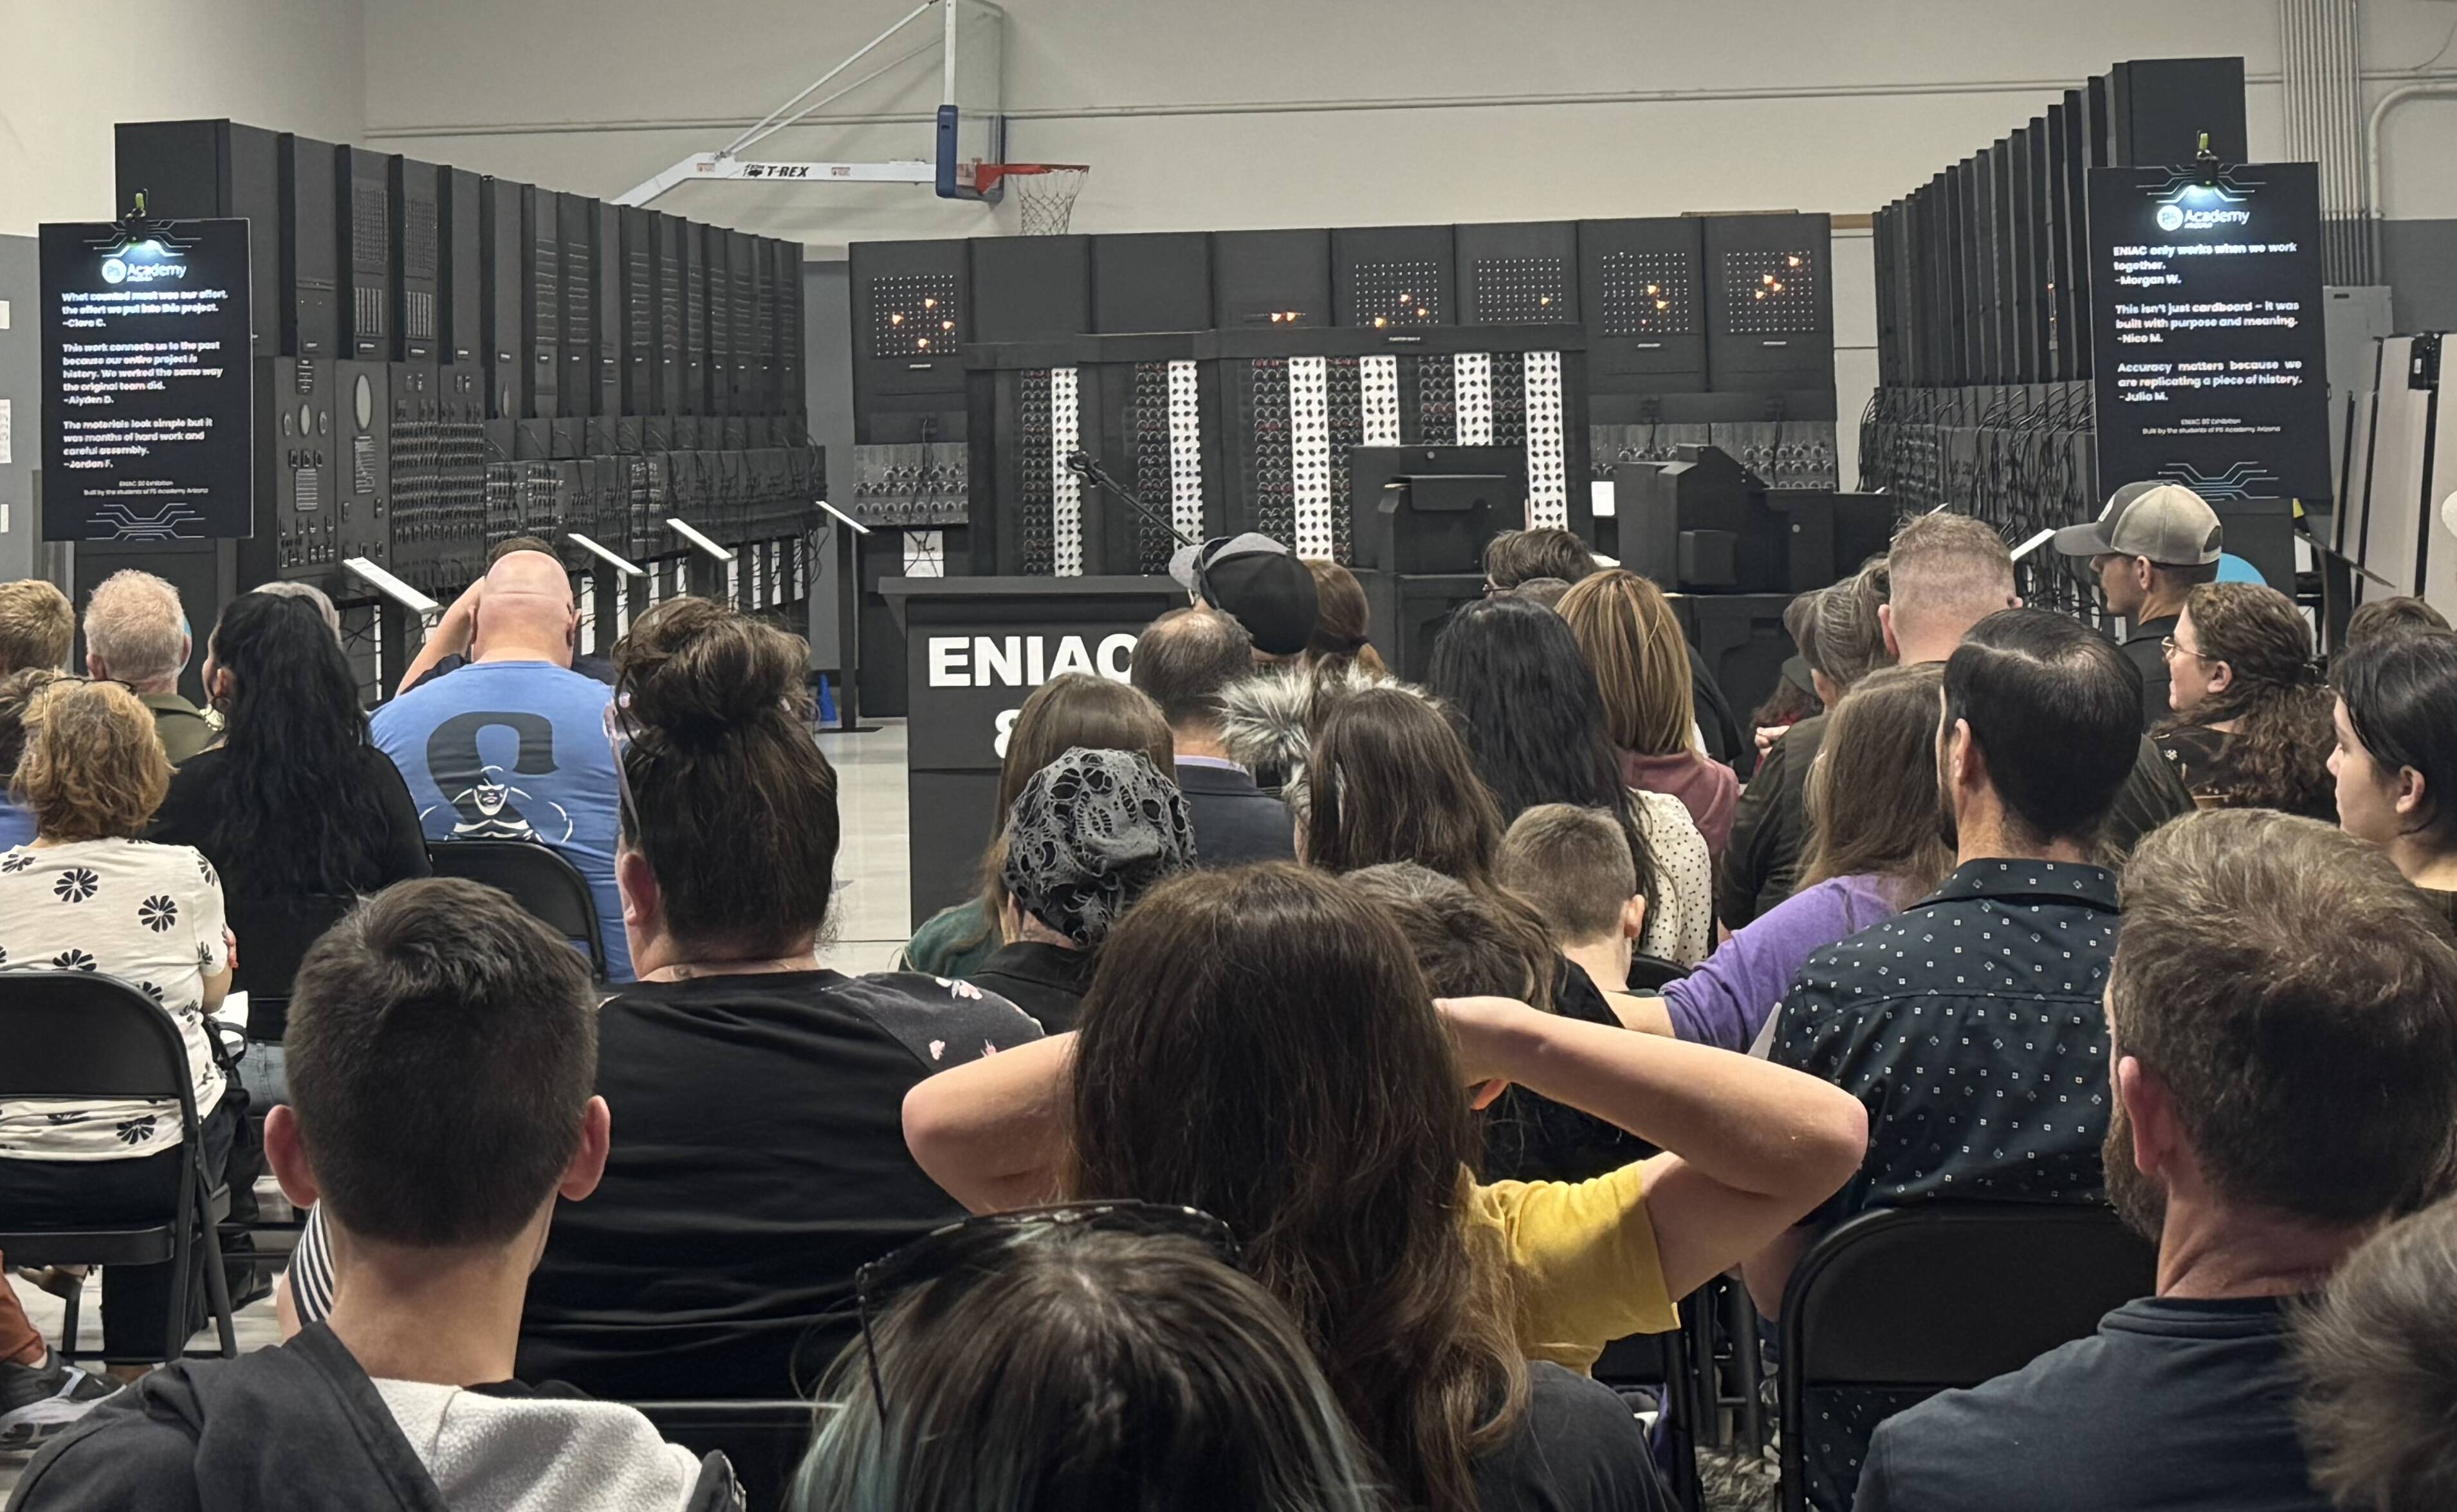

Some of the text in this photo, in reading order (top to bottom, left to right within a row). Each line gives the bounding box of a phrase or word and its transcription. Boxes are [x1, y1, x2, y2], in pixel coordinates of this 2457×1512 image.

[767, 166, 809, 177] T-REX
[2185, 209, 2250, 225] Academy
[2113, 246, 2148, 256] ENIAC
[2150, 245, 2175, 257] only
[2177, 244, 2213, 255] works
[2214, 243, 2247, 254] when
[2268, 243, 2297, 252] work
[127, 263, 187, 278] Academy
[2113, 261, 2166, 272] together.
[2115, 275, 2182, 288] -Morgan W.
[62, 293, 87, 301] What
[132, 291, 158, 300] most
[62, 306, 78, 315] the
[80, 305, 106, 313] effort
[123, 304, 140, 315] put
[141, 304, 160, 313] into
[161, 304, 180, 313] this
[181, 302, 218, 315] project.
[2116, 305, 2139, 314] This
[2168, 303, 2190, 315] just
[2192, 302, 2252, 313] cardboard
[2265, 302, 2273, 311] it
[2276, 302, 2299, 310] was
[2116, 315, 2298, 330] built with purpose and meaning.
[2117, 333, 2163, 343] -Nico M.
[63, 344, 83, 352] This
[84, 344, 108, 352] work
[109, 343, 154, 351] connects
[180, 342, 196, 350] the
[198, 342, 220, 352] past
[63, 357, 104, 365] because
[154, 355, 187, 365] project
[189, 355, 198, 363] is
[2117, 362, 2172, 374] Accuracy
[2178, 362, 2223, 371] matters
[2230, 361, 2279, 371] because
[63, 370, 99, 380] history.
[118, 369, 154, 377] worked
[156, 368, 172, 376] the
[203, 368, 223, 378] way
[64, 381, 165, 393] the original team did.
[2118, 374, 2303, 389] are replicating a piece of history.
[2119, 392, 2168, 401] -Julia M.
[64, 421, 81, 429] The
[83, 420, 129, 429] materials
[131, 419, 151, 428] look
[154, 418, 185, 429] simple
[205, 418, 212, 427] it
[135, 432, 158, 441] hard
[185, 432, 205, 440] and
[64, 446, 149, 456] careful assembly.
[105, 459, 113, 468] F.
[929, 634, 1138, 687] ENIAC
